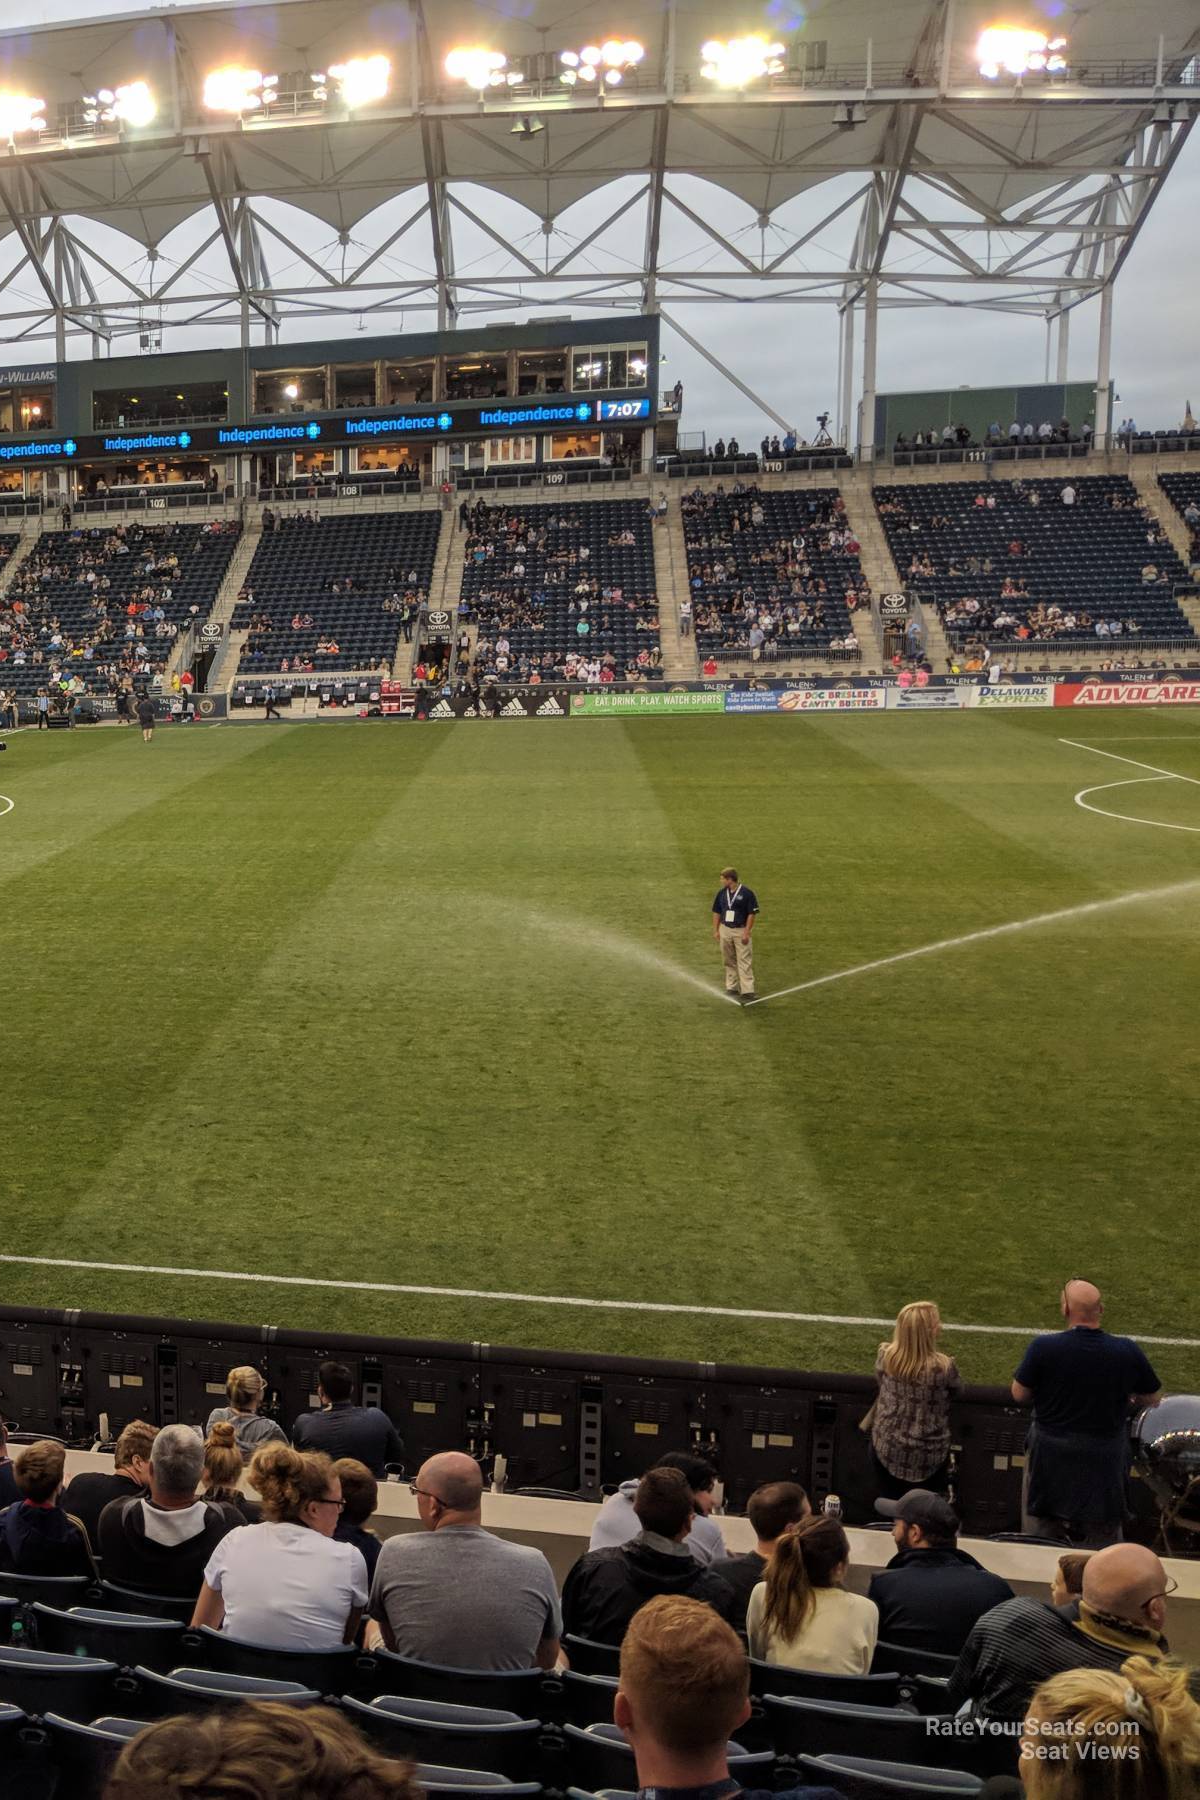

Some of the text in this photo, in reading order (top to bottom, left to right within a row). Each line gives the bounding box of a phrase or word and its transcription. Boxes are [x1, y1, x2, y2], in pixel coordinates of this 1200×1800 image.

[608, 402, 641, 416] 7:07
[481, 406, 573, 425] Independence
[346, 415, 435, 434] Independence
[219, 424, 304, 443] Independence
[105, 434, 176, 451] Independence
[969, 452, 986, 462] 111
[765, 462, 782, 472] 110
[546, 473, 563, 483] 109
[341, 486, 357, 496] 108
[786, 681, 809, 689] TALEN
[978, 687, 1048, 696] DELAWARE
[1075, 684, 1200, 703] ADVOCARE
[663, 695, 690, 704] WATCH
[692, 694, 721, 704] SPORTS
[801, 699, 878, 708] CAVITY BUSTERS
[978, 694, 1047, 705] EXPRESS
